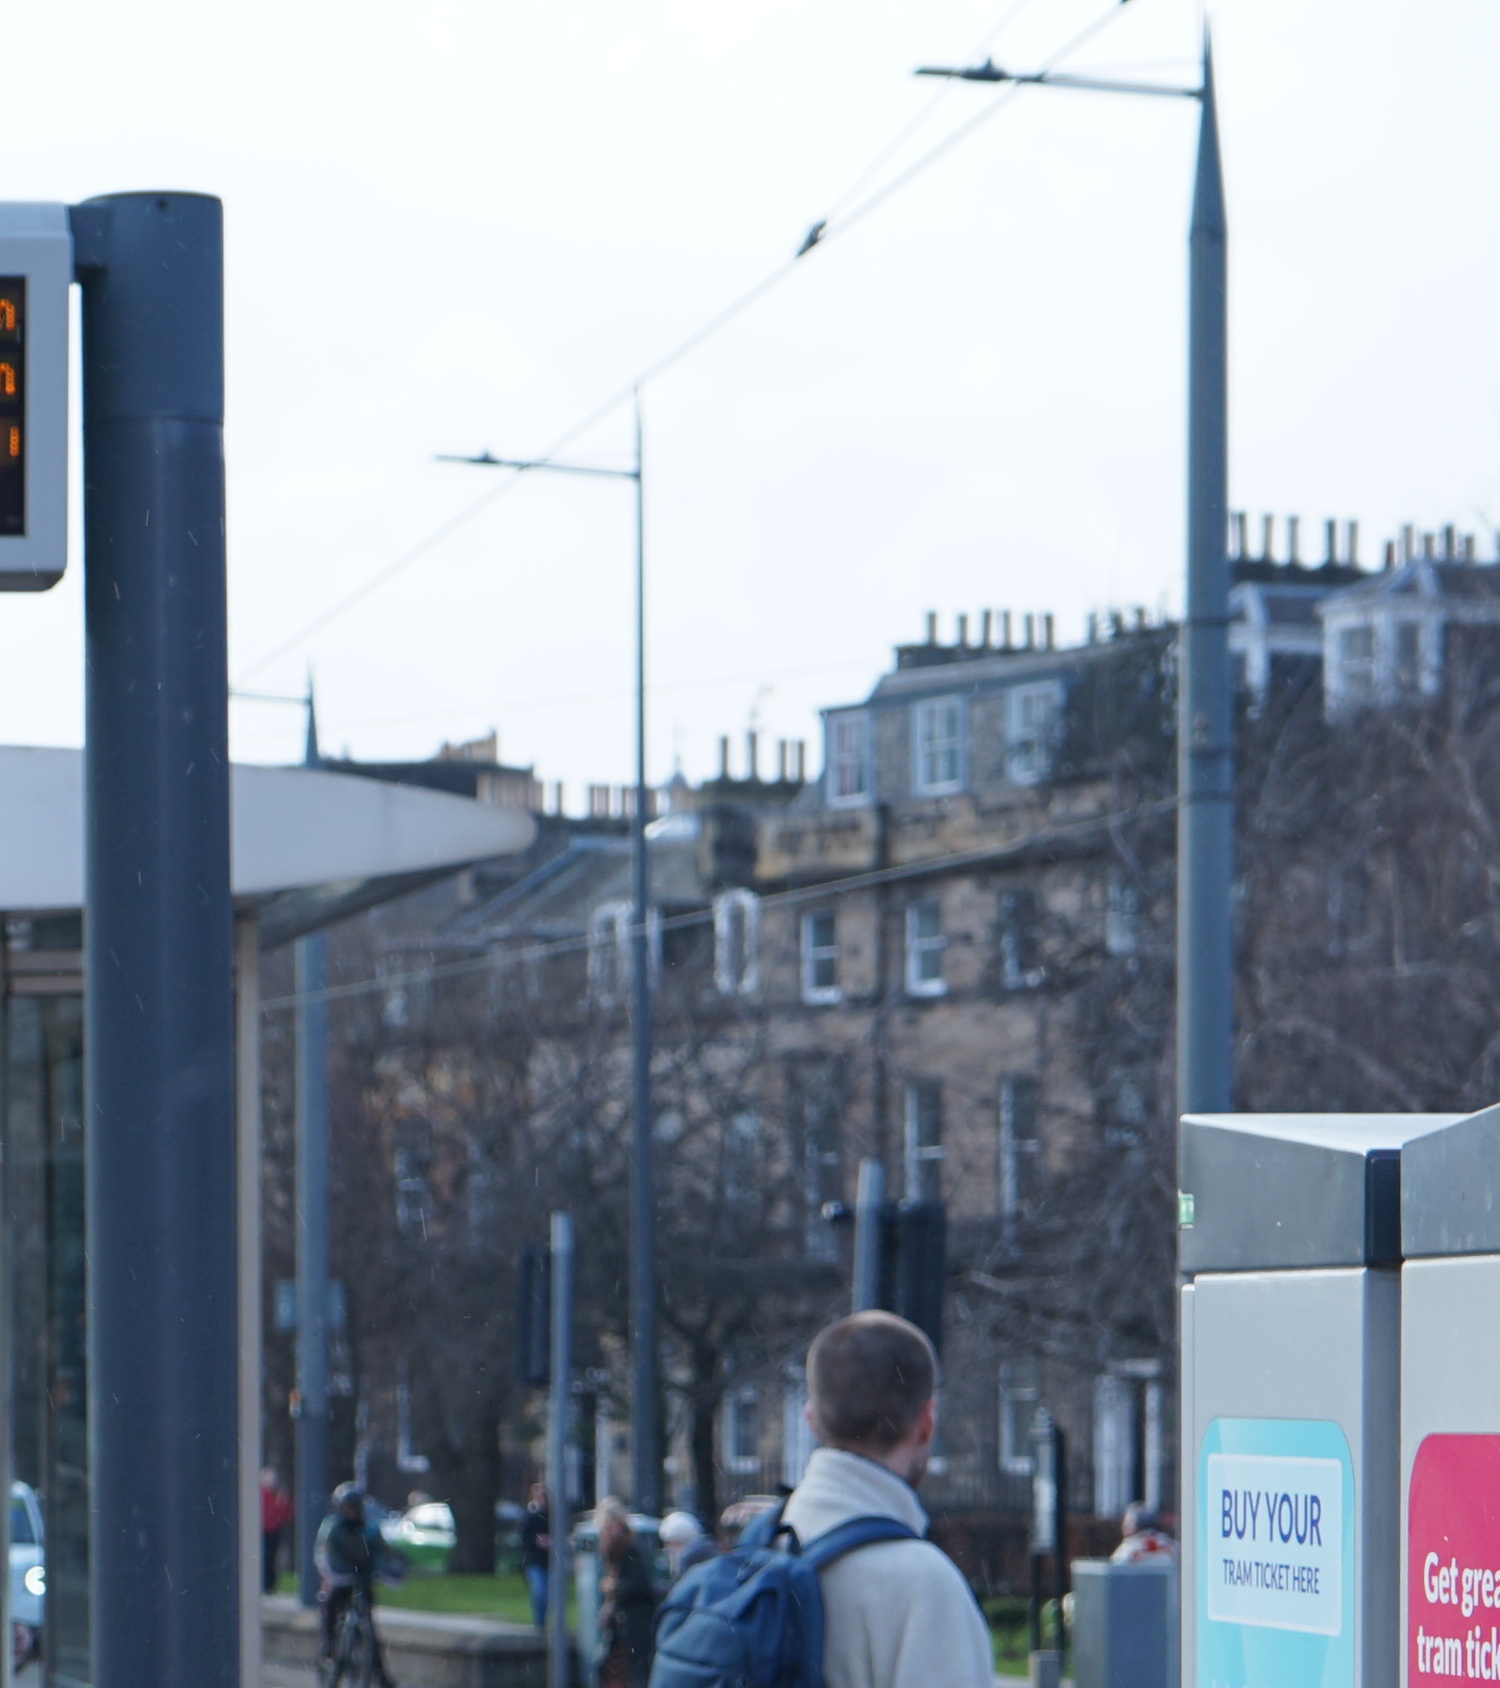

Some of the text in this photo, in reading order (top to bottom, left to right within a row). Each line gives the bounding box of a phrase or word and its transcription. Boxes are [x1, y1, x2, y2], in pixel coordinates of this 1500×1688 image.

[1222, 1489, 1322, 1547] BUY YOUR
[1223, 1559, 1320, 1595] TRAM TICKET HERE
[1423, 1551, 1459, 1605] Get
[1417, 1625, 1462, 1676] tram
